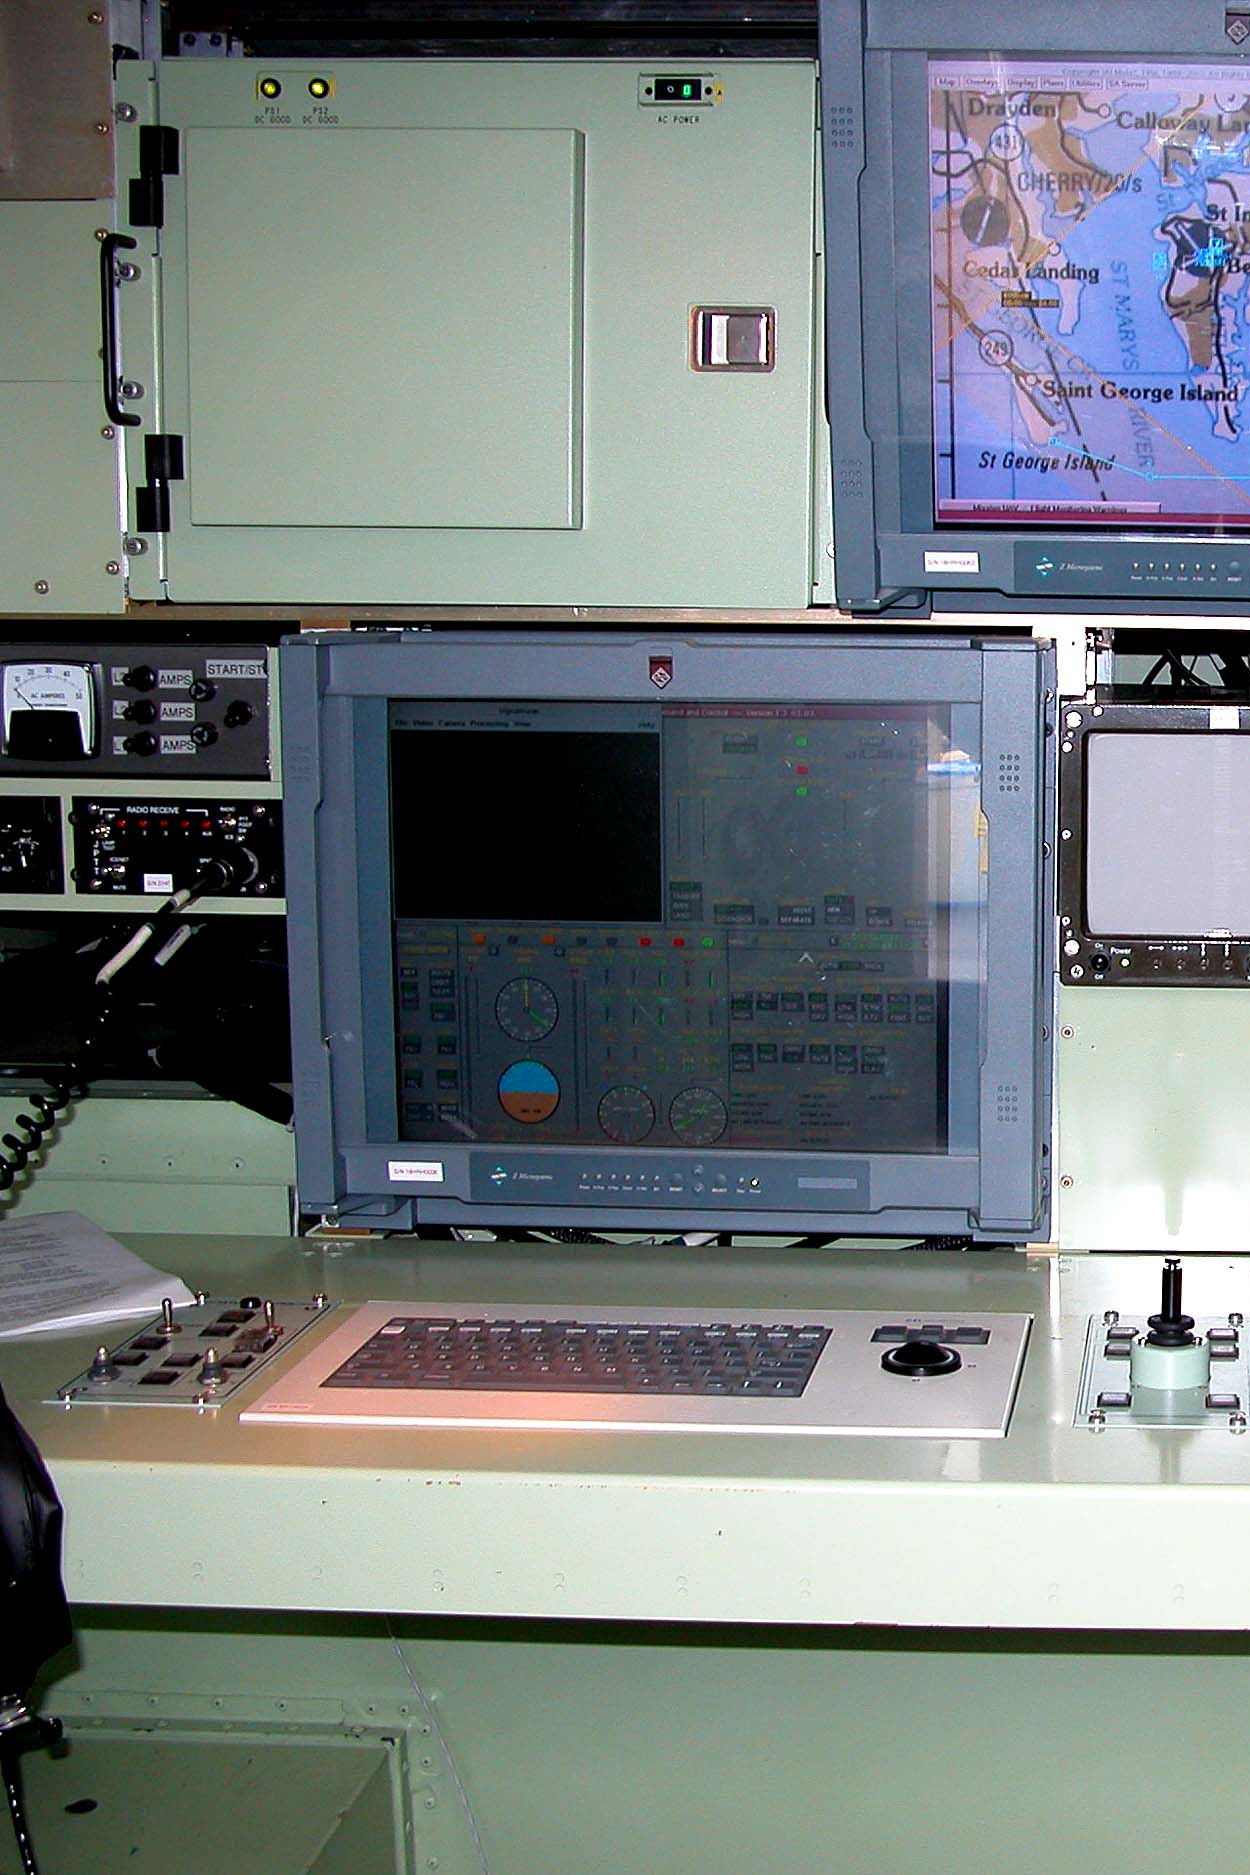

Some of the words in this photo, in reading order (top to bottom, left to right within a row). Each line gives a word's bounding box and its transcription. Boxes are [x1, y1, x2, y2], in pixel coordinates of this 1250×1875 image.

[968, 97, 1057, 119] Drayden
[658, 115, 668, 124] AC
[672, 115, 700, 124] POWER
[1116, 111, 1211, 132] Calloway
[1205, 204, 1227, 220] St
[1042, 381, 1093, 399] Saint
[1100, 382, 1174, 402] George
[1180, 383, 1240, 401] Island
[978, 451, 999, 469] St
[1002, 451, 1060, 473] George
[1064, 453, 1115, 471] Island
[160, 674, 192, 686] AMPS
[161, 707, 194, 719] AMPS
[162, 740, 195, 751] AMPS
[126, 806, 149, 814] RADIO
[150, 806, 180, 815] RECEIVE
[1110, 946, 1132, 955] Power
